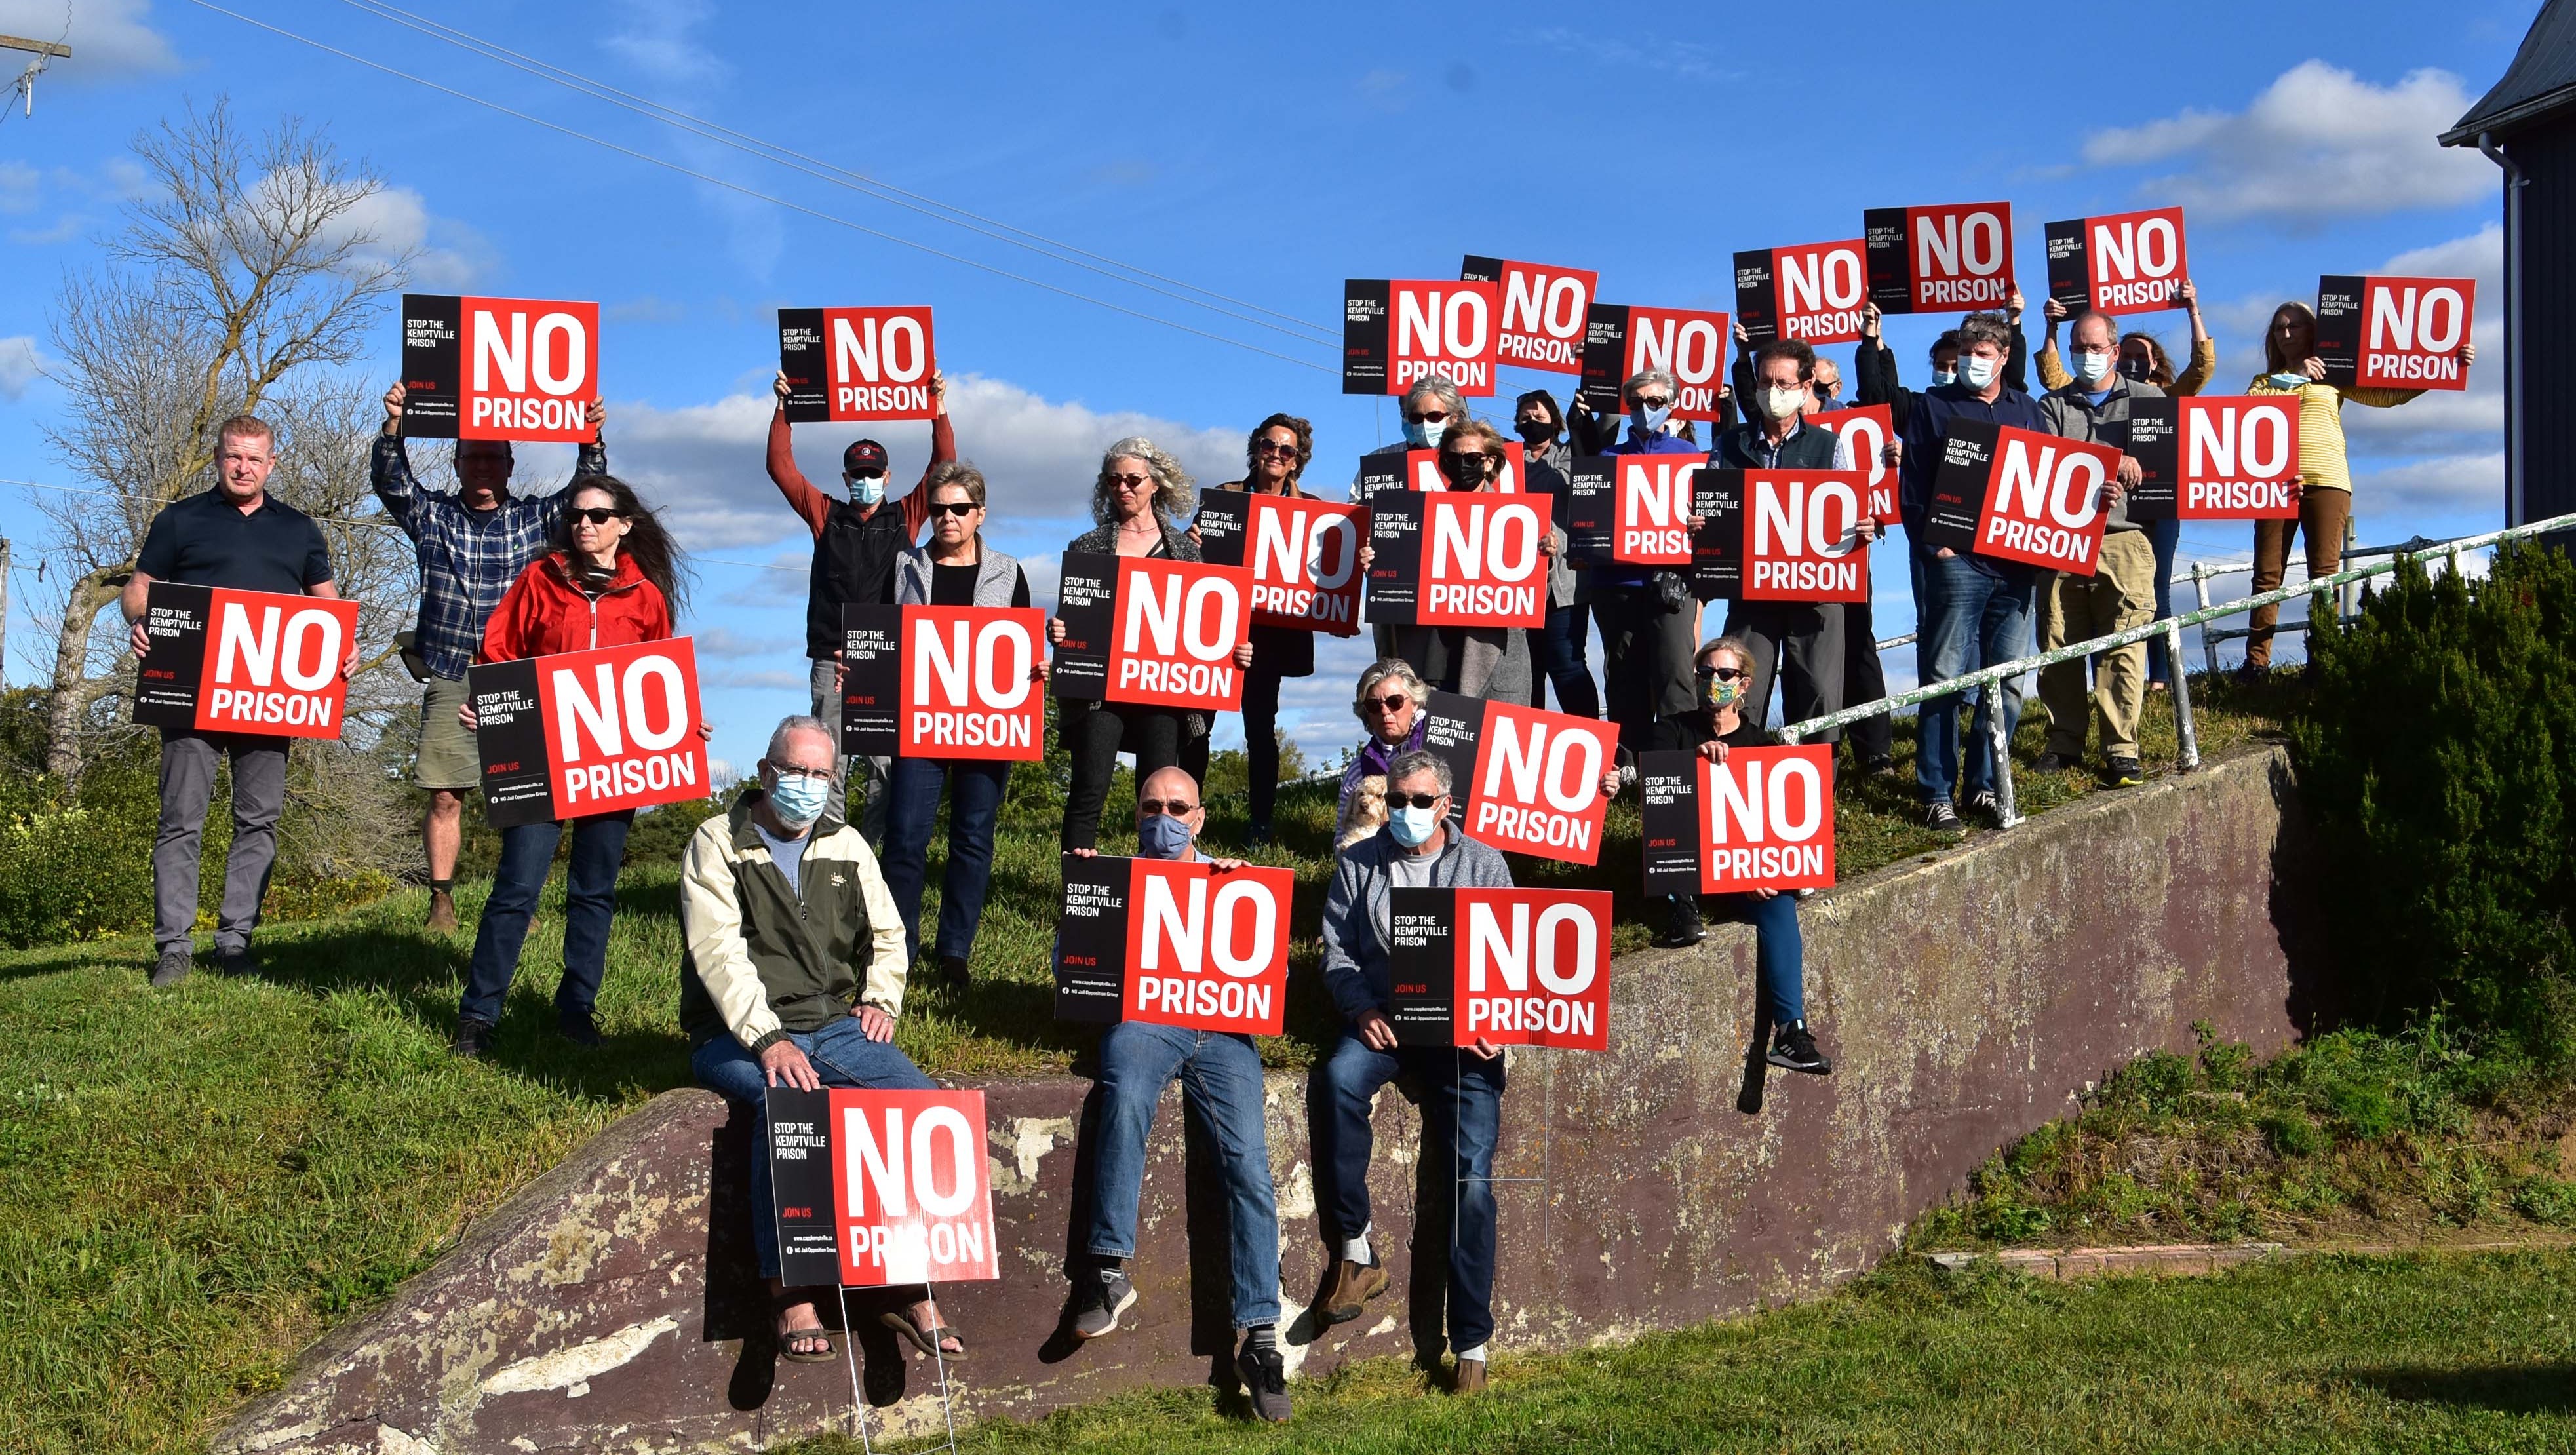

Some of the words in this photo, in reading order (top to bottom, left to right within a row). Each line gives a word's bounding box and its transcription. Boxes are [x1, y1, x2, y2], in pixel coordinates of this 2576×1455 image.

[1916, 212, 2003, 277] NO
[2094, 218, 2177, 282] NO
[1781, 248, 1862, 313] NO
[1920, 277, 2005, 303] PRISON
[2098, 277, 2180, 308] PRISON
[1501, 270, 1586, 338] NO
[2321, 301, 2358, 309] KEMPTVILLE
[407, 319, 427, 328] STOP
[428, 320, 444, 329] THE
[1397, 290, 1487, 359] NO
[1786, 309, 1865, 339] PRISON
[2369, 286, 2463, 353] NO
[407, 328, 454, 339] KEMPTVILLE
[407, 338, 435, 347] PRISON
[834, 315, 925, 383] NO
[1497, 332, 1576, 365] PRISON
[473, 310, 585, 395] NO
[1632, 317, 1718, 385] NO
[1397, 360, 1486, 387] PRISON
[2367, 353, 2458, 380] PRISON
[838, 385, 927, 412] PRISON
[473, 397, 585, 431] PRISON
[1948, 438, 1966, 448] STOP
[1967, 441, 1981, 452] THE
[2189, 405, 2288, 478] NO
[1820, 417, 1886, 487] O
[1946, 446, 1989, 462] KEMPTVILLE
[1944, 454, 1970, 467] PRISON
[1993, 438, 2105, 528] NO
[1696, 492, 1714, 500] STOP
[1715, 492, 1728, 500] THE
[2188, 481, 2288, 509] PRISON
[1696, 500, 1738, 509] KEMPTVILLE
[1201, 510, 1219, 520] STOP
[1220, 512, 1234, 522] THE
[1375, 513, 1394, 521] STOP
[1394, 513, 1409, 522] THE
[1696, 509, 1721, 517] PRISON
[1754, 480, 1857, 558] NO
[1200, 518, 1242, 531] KEMPTVILLE
[1200, 527, 1224, 537] PRISON
[1375, 521, 1418, 530] KEMPTVILLE
[1374, 530, 1400, 539] PRISON
[1431, 503, 1538, 582] NO
[1624, 530, 1692, 554] PRIS
[1986, 516, 2091, 563] PRISON
[1254, 506, 1363, 589] NO
[1064, 576, 1085, 587] STOP
[1085, 578, 1101, 588] THE
[1753, 560, 1856, 591] PRISON
[1064, 586, 1110, 598] KEMPTVILLE
[1429, 584, 1535, 615] PRISON
[1063, 595, 1091, 606] PRISON
[1251, 584, 1350, 623] PRISON
[151, 607, 173, 617] STOP
[174, 610, 191, 619] THE
[1123, 570, 1239, 661] NO
[148, 626, 180, 637] PRISON
[149, 617, 202, 630] KEMPTVILLE
[846, 630, 867, 640] STOP
[868, 630, 884, 640] THE
[214, 602, 342, 691] NO
[846, 640, 895, 650] KEMPTVILLE
[846, 650, 875, 659] PRISON
[914, 619, 1032, 709] NO
[144, 669, 163, 678] JOIN
[1120, 658, 1232, 698] PRISON
[477, 693, 500, 705] STOP
[501, 689, 520, 701] THE
[846, 695, 863, 704] JOIN
[865, 696, 874, 705] US
[210, 688, 332, 727] PRISON
[478, 699, 534, 716] KEMPTVILLE
[552, 655, 688, 762] NO
[480, 712, 513, 726] PRISON
[1430, 715, 1450, 727] STOP
[1451, 719, 1466, 730] THE
[913, 711, 1030, 747] PRISON
[1428, 724, 1475, 741] KEMPTVILLE
[1426, 733, 1454, 747] PRISON
[487, 764, 507, 774] JOIN
[508, 762, 520, 771] US
[1483, 715, 1603, 813] NO
[564, 750, 695, 803] PRISON
[1645, 777, 1665, 786] STOP
[1666, 776, 1681, 785] THE
[1645, 785, 1692, 795] KEMPTVILLE
[1646, 795, 1673, 805] PRISON
[1709, 757, 1822, 844] NO
[1477, 801, 1591, 851] PRISON
[1648, 839, 1664, 847] JOIN
[1712, 845, 1823, 880] PRISON
[1067, 883, 1091, 895] STOP
[1092, 885, 1110, 896] THE
[1066, 894, 1122, 908] KEMPTVILLE
[1066, 905, 1099, 917] PRISON
[1140, 874, 1276, 978] NO
[1394, 915, 1417, 925] STOP
[1418, 916, 1435, 925] THE
[1394, 925, 1448, 936] KEMPTVILLE
[1394, 936, 1426, 946] PRISON
[1469, 902, 1597, 995] NO
[1064, 955, 1083, 965] JOIN
[1085, 957, 1096, 966] US
[1395, 984, 1414, 992] JOIN
[1415, 984, 1426, 992] US
[1137, 976, 1271, 1020] PRISON
[1468, 997, 1595, 1036] PRISON
[774, 1122, 796, 1134] STOP
[797, 1123, 814, 1135] THE
[775, 1135, 826, 1147] KEMPTVILLE
[776, 1148, 807, 1159] PRISON
[844, 1106, 977, 1217] NO
[782, 1207, 800, 1218] JOIN
[801, 1207, 811, 1218] US
